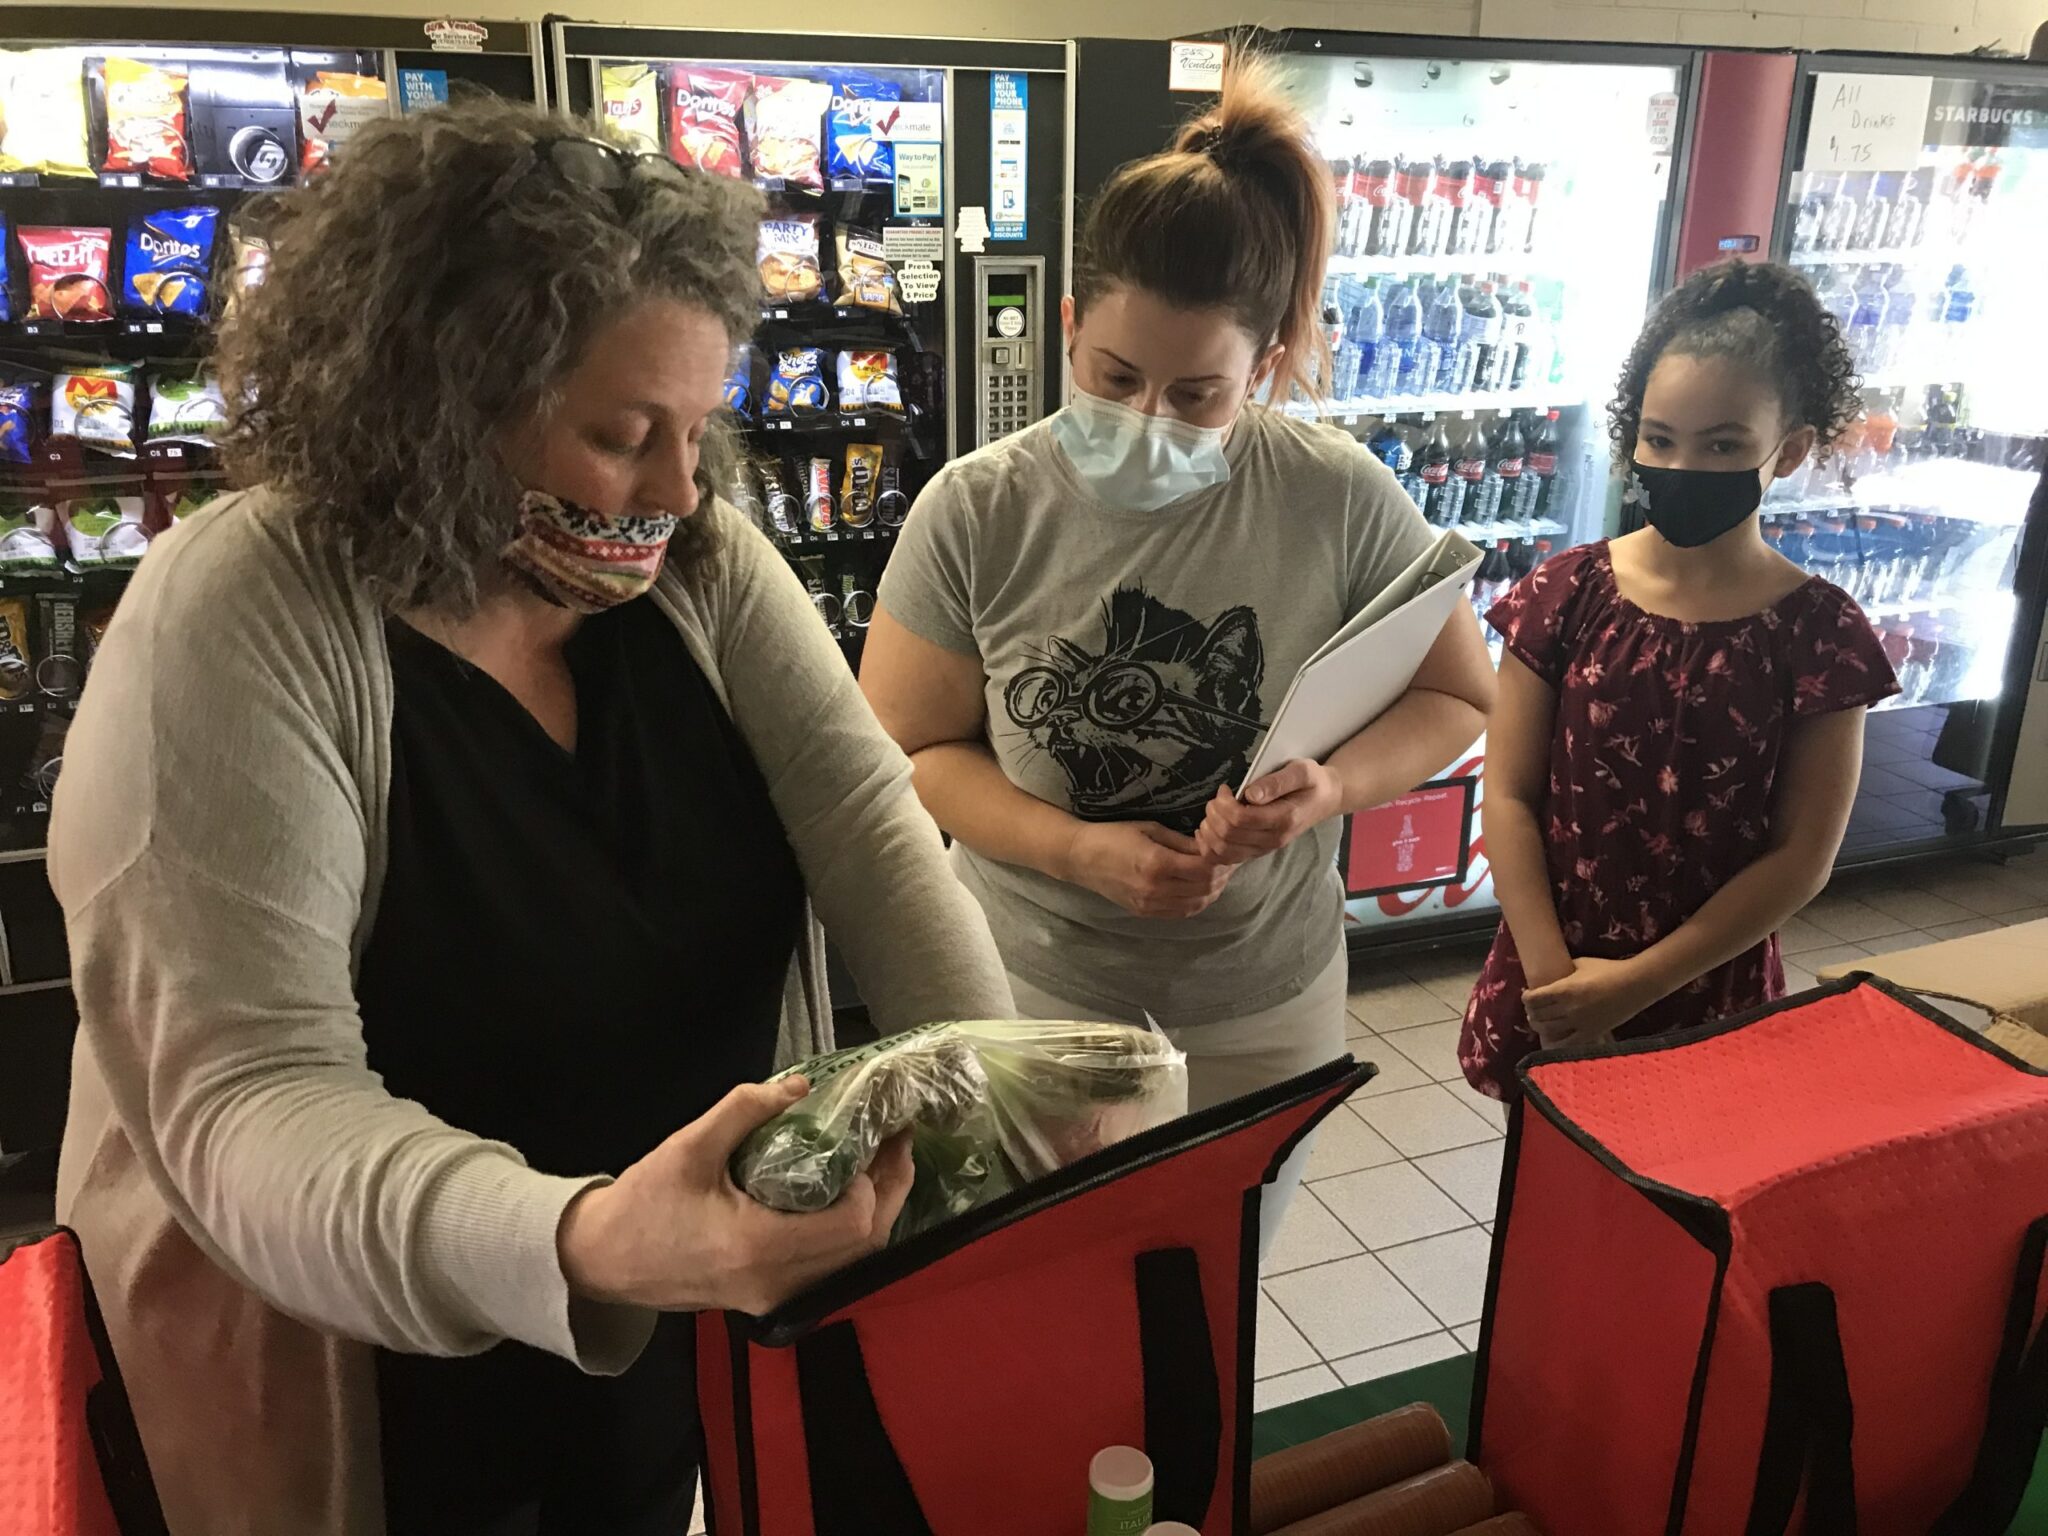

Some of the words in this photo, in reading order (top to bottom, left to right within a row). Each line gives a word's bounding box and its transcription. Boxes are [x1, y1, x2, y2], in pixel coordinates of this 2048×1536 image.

[1180, 57, 1222, 73] Vending
[405, 72, 424, 82] PAY
[994, 73, 1009, 82] PAY
[405, 82, 432, 92] WITH
[994, 82, 1016, 90] WITH
[994, 90, 1017, 98] YOUR
[1831, 83, 1862, 111] All
[994, 97, 1023, 106] PHONE
[1934, 106, 2034, 125] STARBUCKS
[899, 153, 913, 162] Way
[764, 222, 809, 237] PARTY
[140, 232, 201, 260] Doritos
